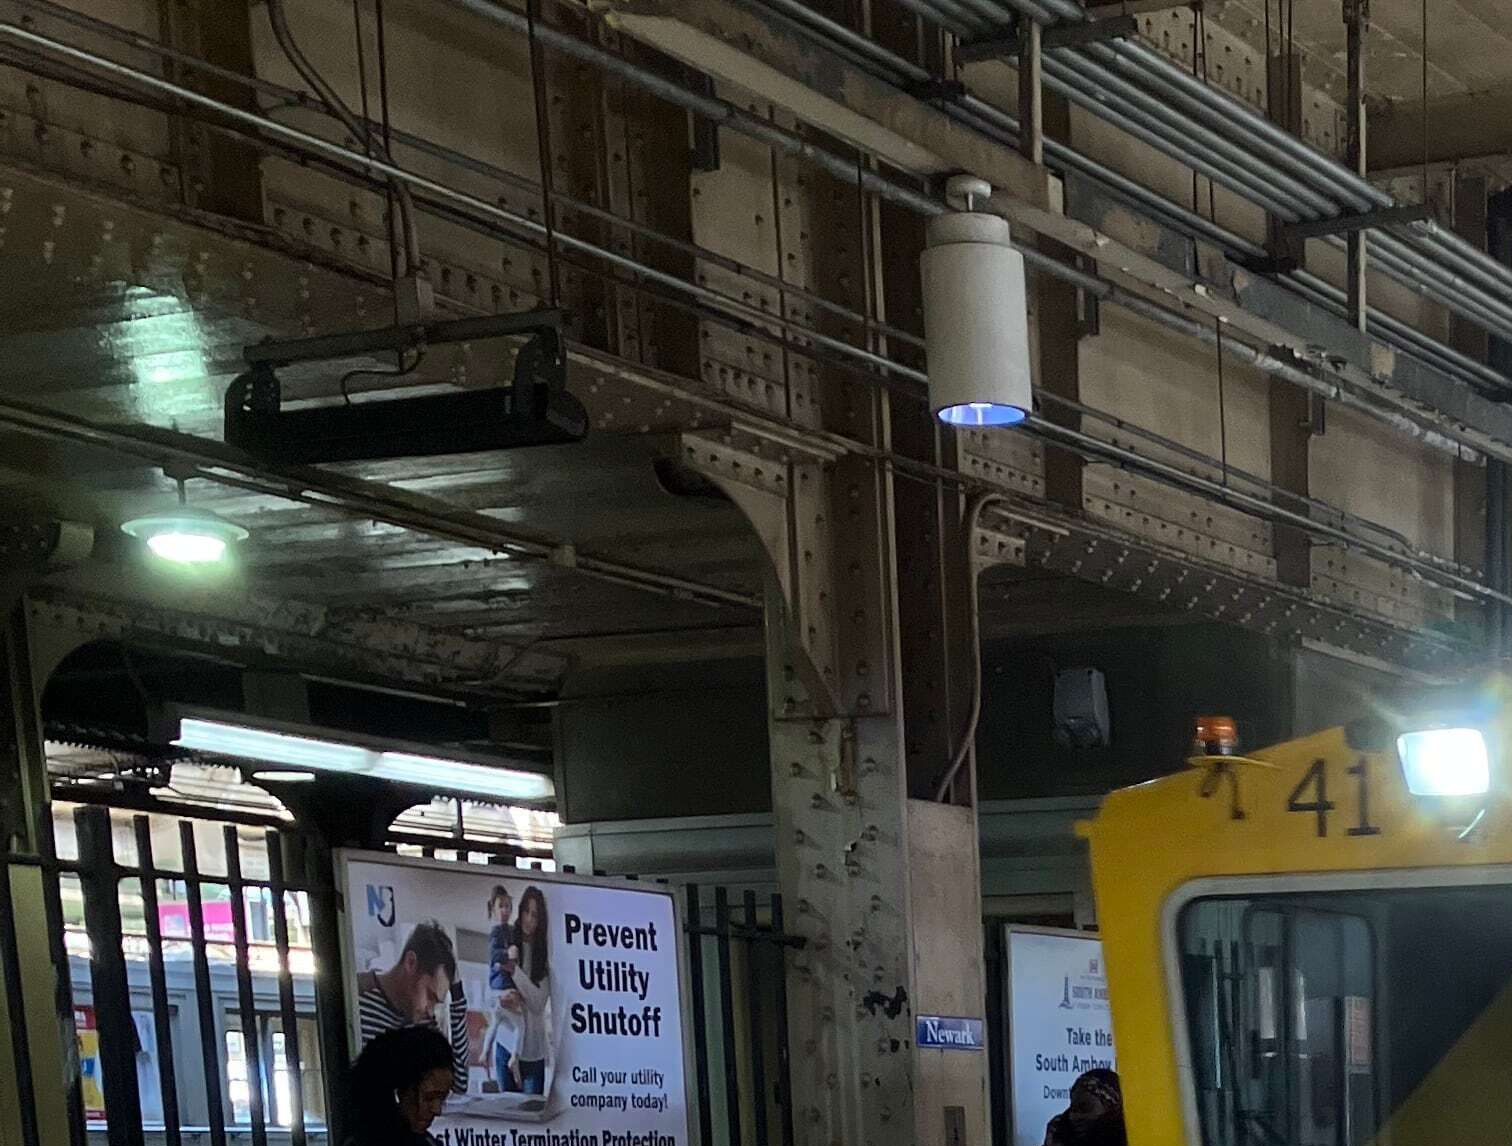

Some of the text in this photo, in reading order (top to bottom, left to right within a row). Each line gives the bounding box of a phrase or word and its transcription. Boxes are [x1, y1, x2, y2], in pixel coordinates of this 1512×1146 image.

[366, 884, 396, 927] NJ
[564, 912, 658, 952] Prevent
[578, 958, 650, 1001] Utility
[570, 1002, 662, 1038] Shutoff
[925, 1020, 976, 1046] Newark
[1066, 1027, 1112, 1046] Take the
[1035, 1053, 1069, 1072] South
[572, 1066, 665, 1088] Call your utility
[570, 1093, 669, 1112] company today!
[1043, 1085, 1072, 1100] Down
